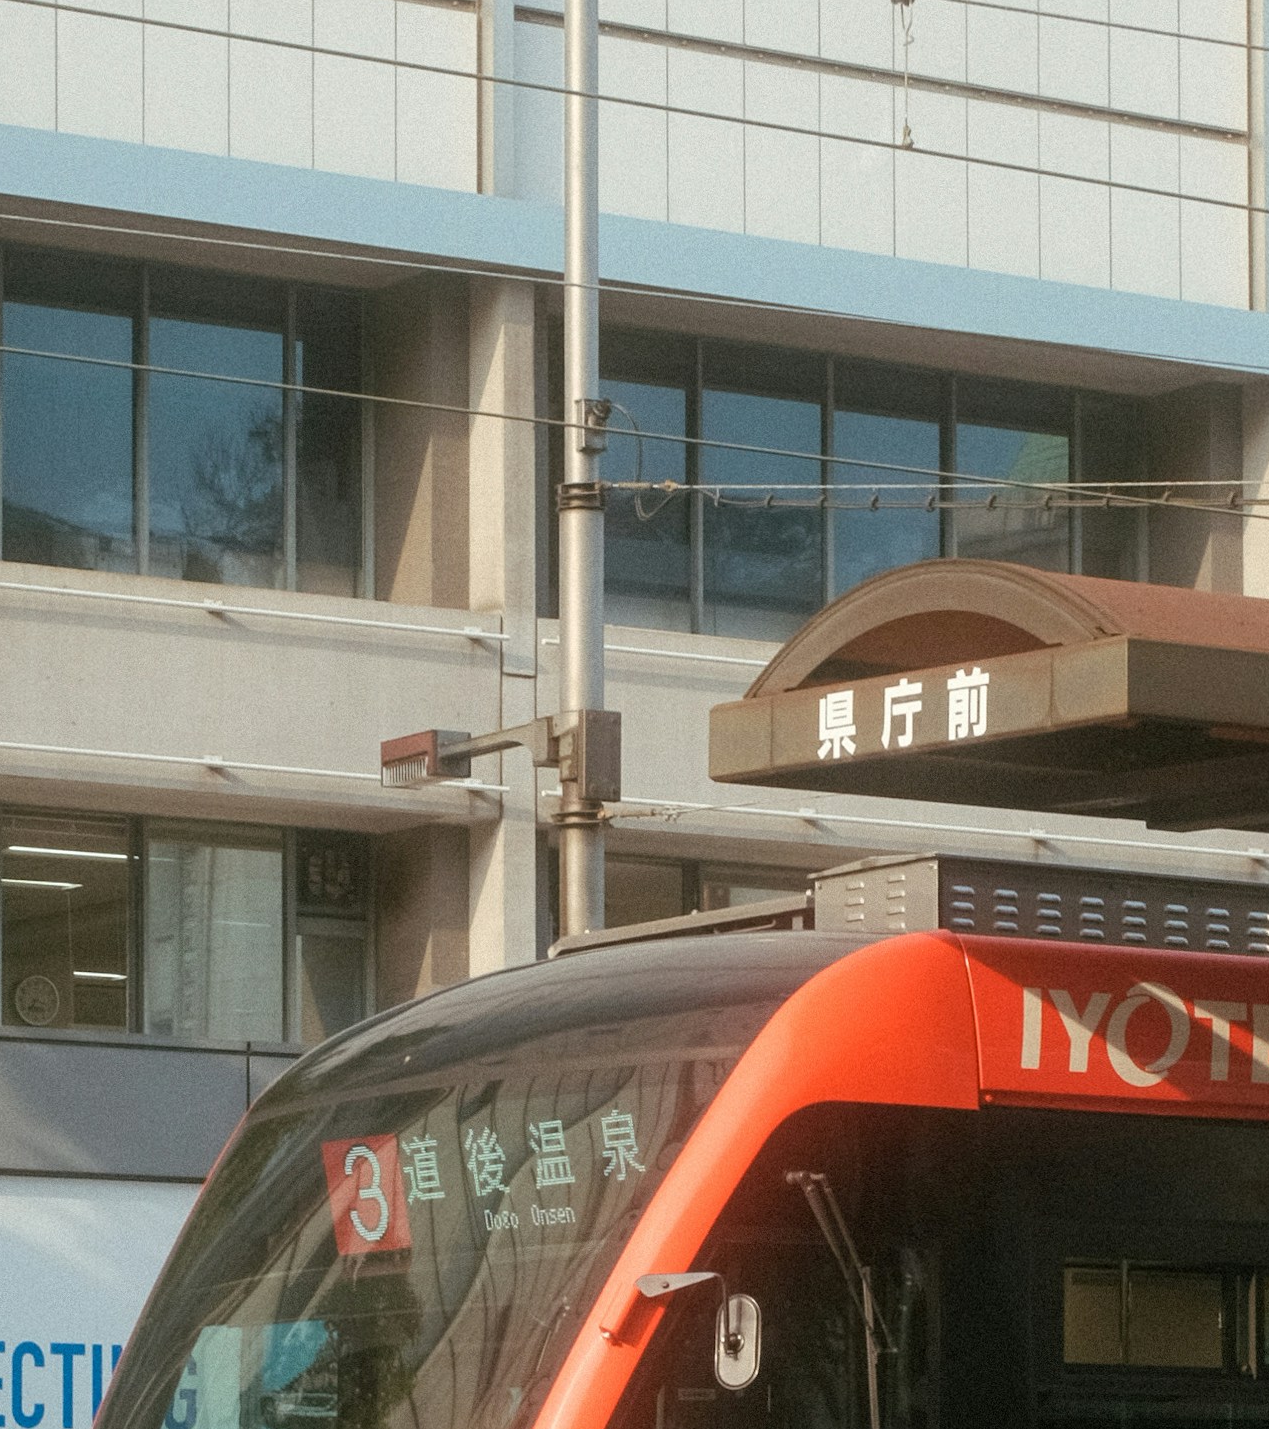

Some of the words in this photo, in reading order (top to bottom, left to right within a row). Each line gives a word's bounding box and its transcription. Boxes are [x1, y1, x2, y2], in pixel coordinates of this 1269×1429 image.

[816, 666, 990, 760] 県庁前
[344, 1143, 389, 1241] 3
[402, 1109, 646, 1204] 道後温泉
[531, 1204, 576, 1225] Onsen
